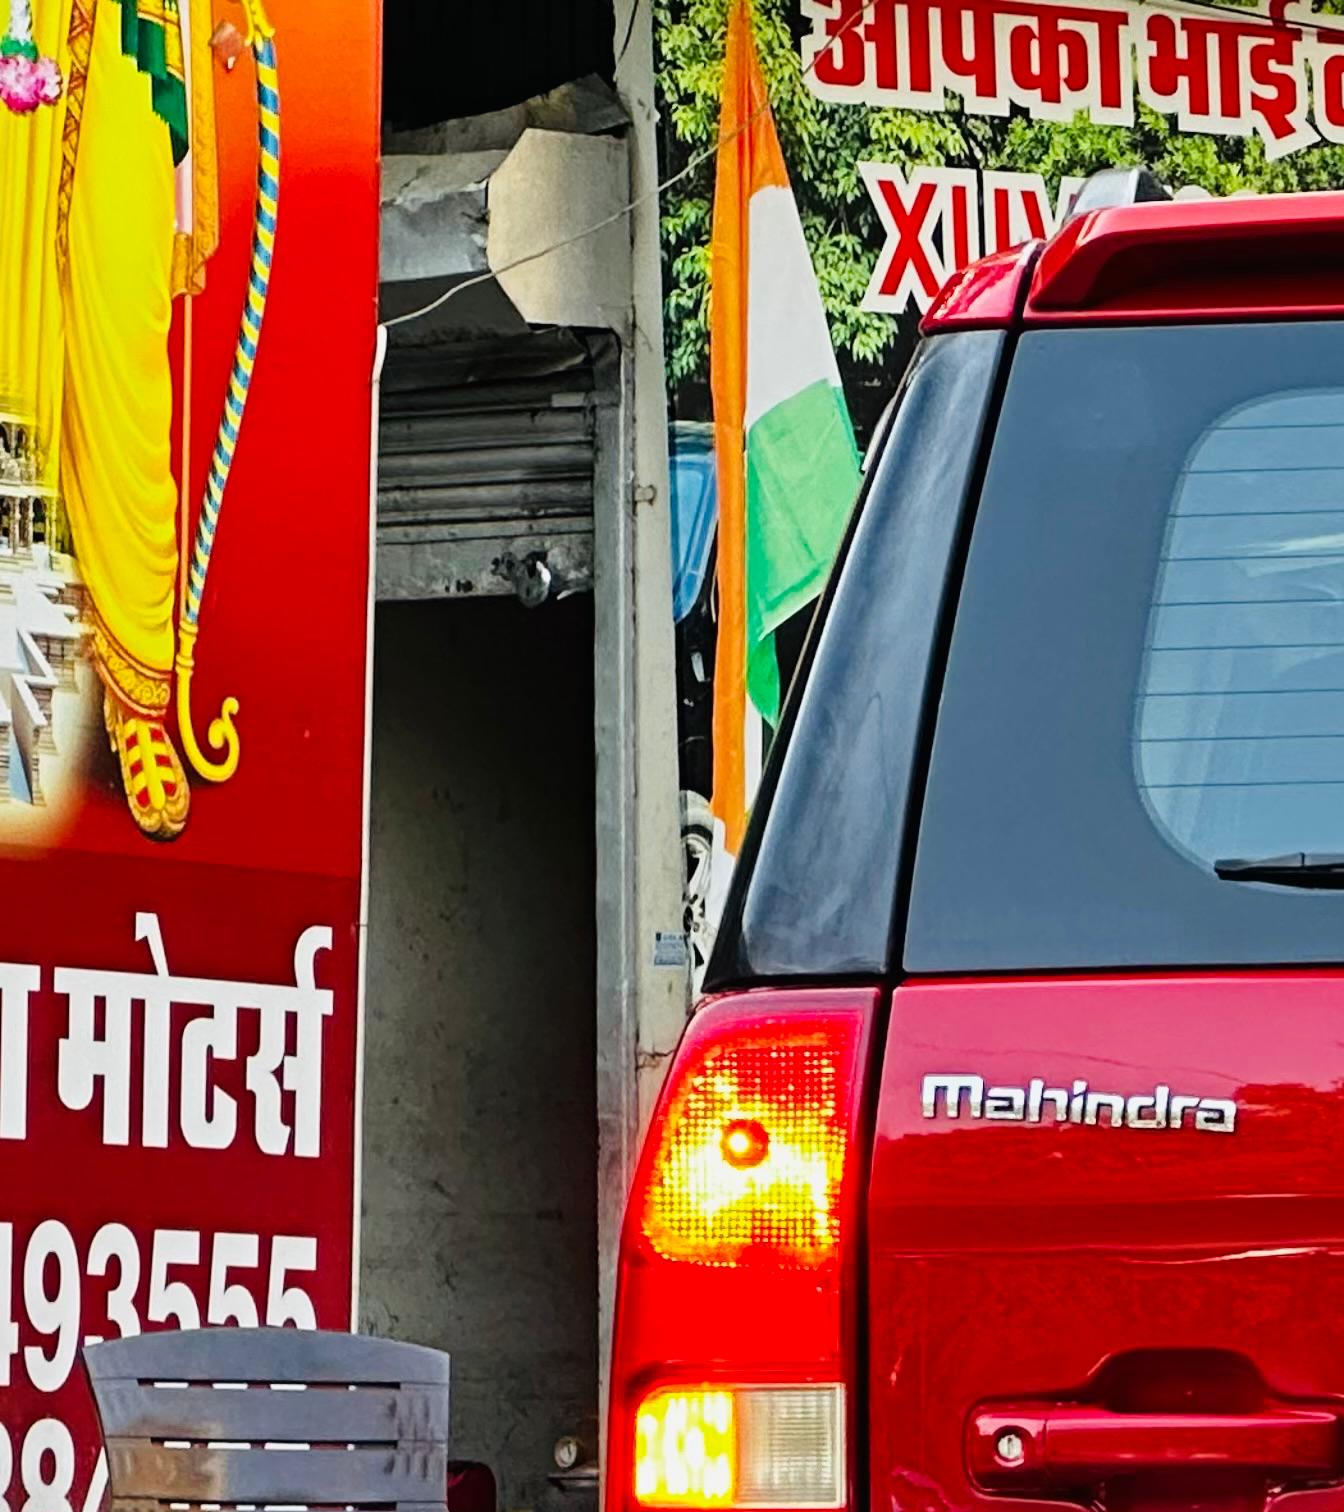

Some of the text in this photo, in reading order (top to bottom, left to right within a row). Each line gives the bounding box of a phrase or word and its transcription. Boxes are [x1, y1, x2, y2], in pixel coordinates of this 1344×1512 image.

[814, 0, 1130, 109] आपका
[1147, 0, 1302, 139] भाई
[54, 911, 333, 1158] मोटर्स
[922, 1073, 1237, 1132] Mahindra
